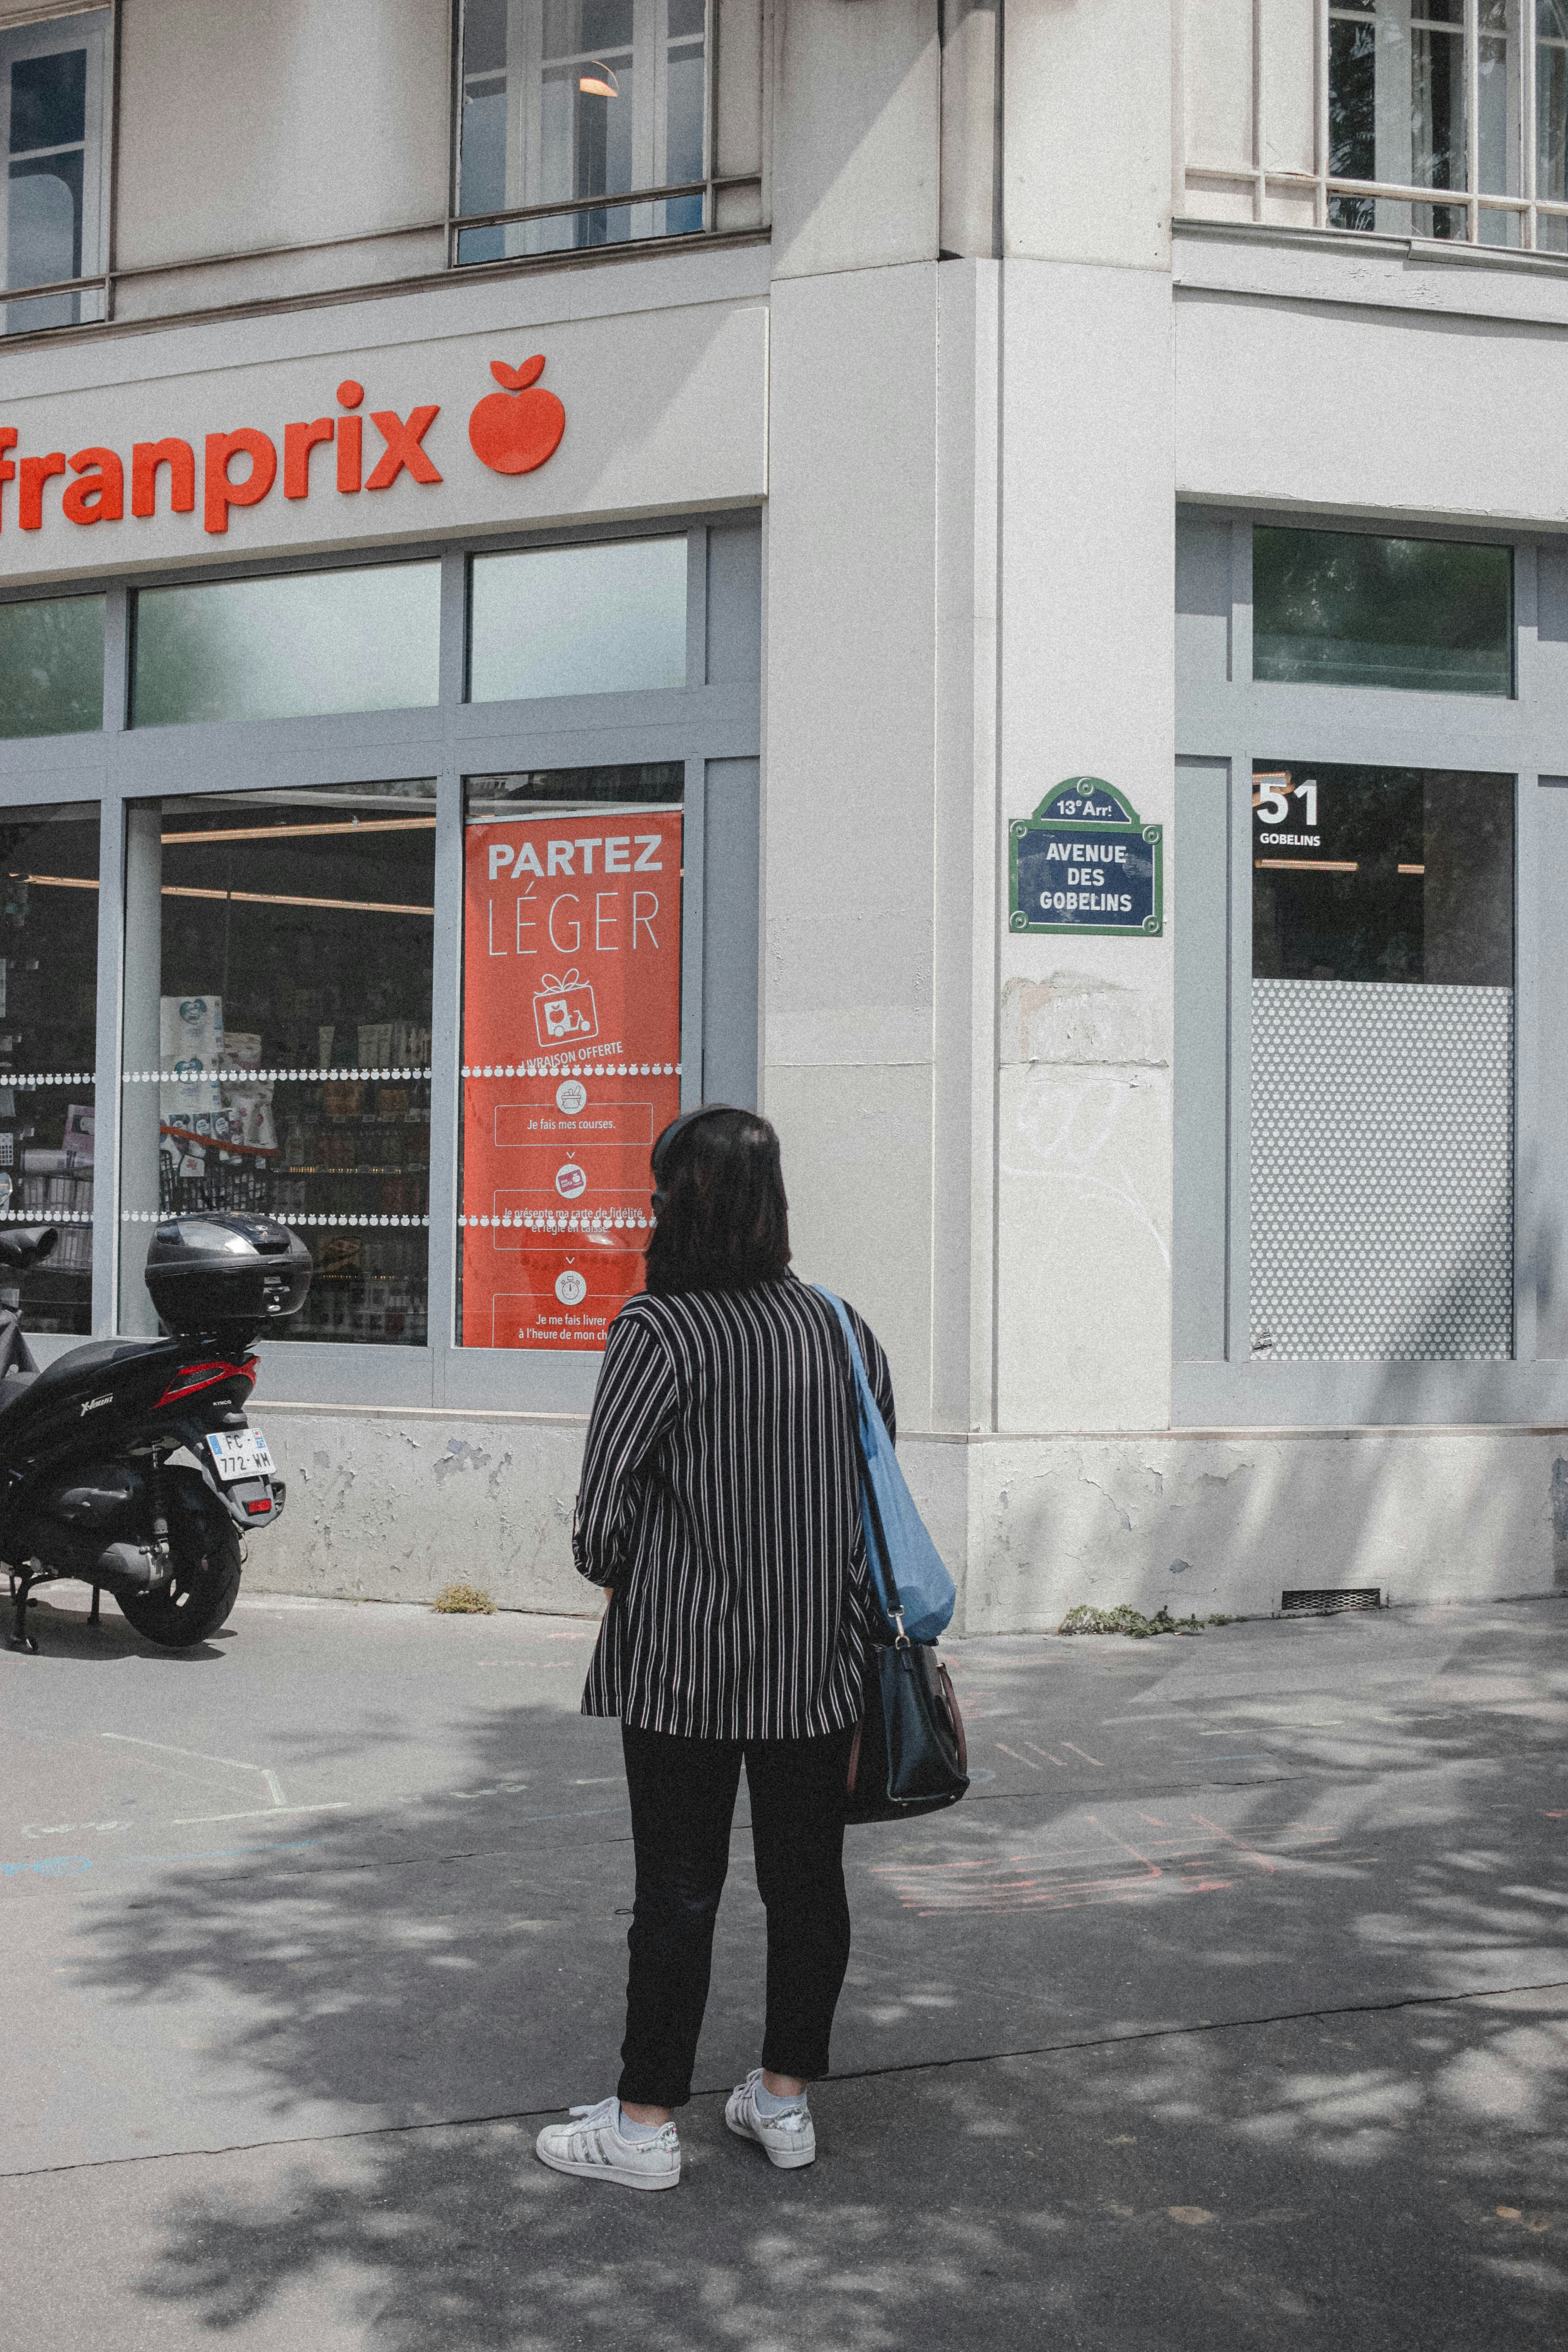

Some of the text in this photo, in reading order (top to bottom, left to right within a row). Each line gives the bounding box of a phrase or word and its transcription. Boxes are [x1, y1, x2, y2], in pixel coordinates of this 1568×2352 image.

[1257, 777, 1317, 826] 51
[1259, 833, 1321, 846] GOBELINS
[489, 834, 662, 880] PARTEZ
[1046, 843, 1127, 863] AVENUE
[1068, 867, 1104, 886] DES
[1040, 891, 1132, 912] GOBELINS
[489, 881, 659, 955] LÉGER
[521, 1041, 623, 1071] LIVRAISON OFFERTE
[527, 1118, 616, 1130] Je fais mes courses.
[504, 1207, 512, 1218] Je
[514, 1207, 553, 1219] présente
[571, 1209, 593, 1218] carte
[596, 1207, 607, 1218] de
[609, 1207, 642, 1218] fidélité
[536, 1314, 606, 1325] Je me fais livrer
[519, 1328, 524, 1338] à
[560, 1328, 571, 1339] de
[574, 1332, 595, 1340] mon
[597, 1329, 608, 1340] ch
[220, 1452, 271, 1473] 772-WM
